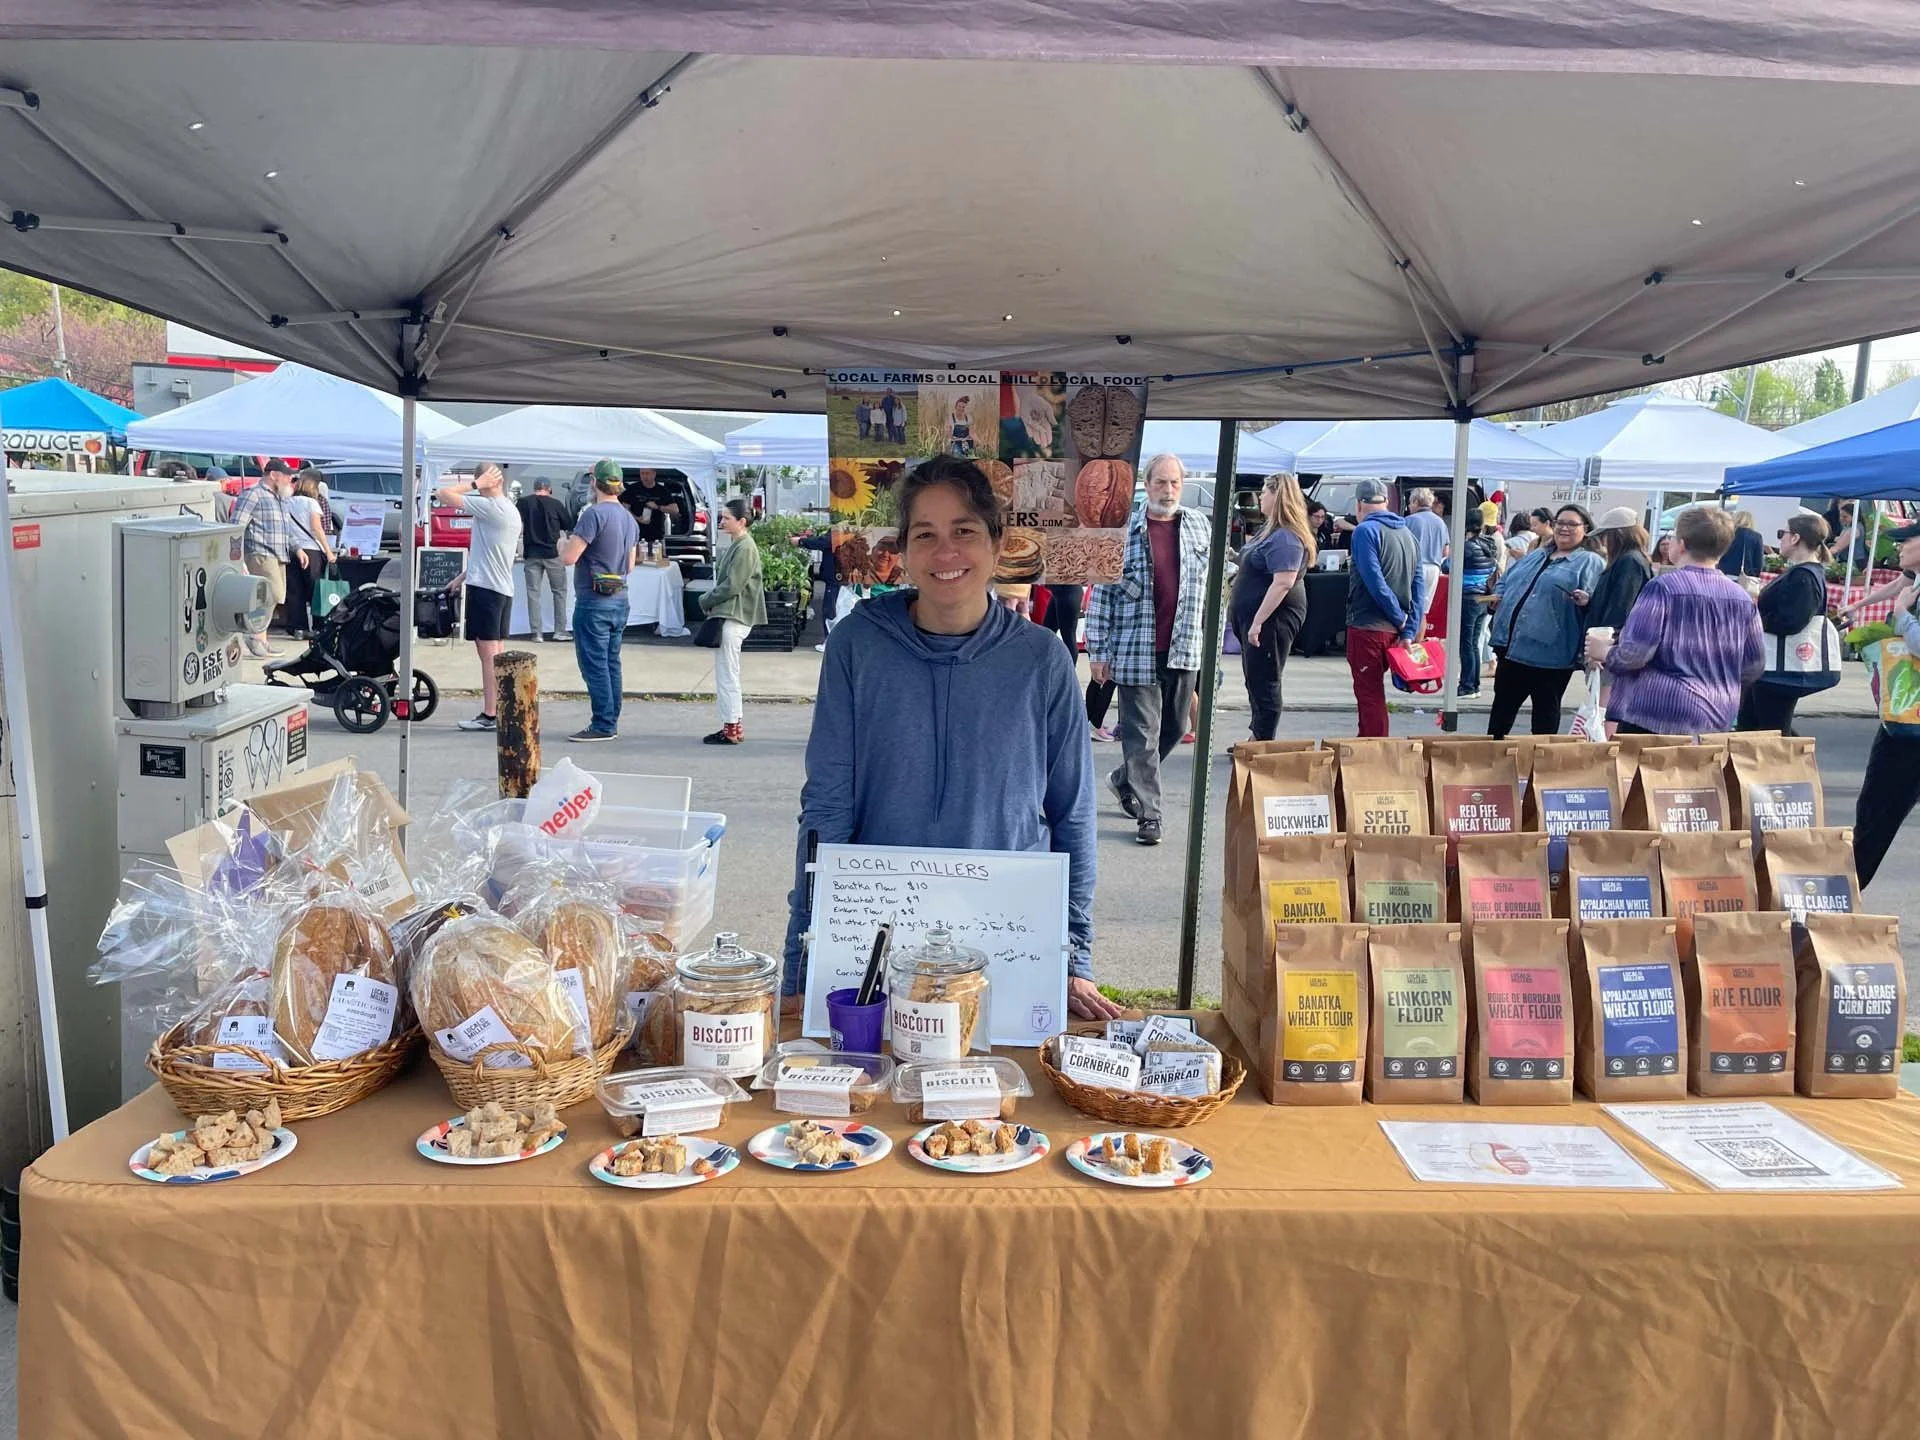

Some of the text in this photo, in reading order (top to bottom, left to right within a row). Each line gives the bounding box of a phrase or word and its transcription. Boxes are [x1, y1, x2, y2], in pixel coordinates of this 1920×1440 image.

[829, 372, 878, 383] LOCAL
[884, 373, 934, 383] FARMS
[948, 374, 997, 384] LOCAL
[1001, 374, 1036, 384] MILL
[1050, 375, 1098, 385] LOCAL
[2, 433, 83, 451] RODUCE
[202, 648, 222, 670] ESE
[1460, 804, 1498, 818] RED FIFE
[1546, 810, 1609, 821] APPALACHIAN WHITE
[1667, 807, 1708, 821] SOFT RED
[1754, 802, 1813, 816] BLUE CLARAGE
[1268, 814, 1329, 830] BUCKWHEAT
[1364, 810, 1409, 825] SPELT
[1449, 817, 1511, 832] WHEAT FLOUR
[1760, 816, 1810, 830] CORN GRITS
[1546, 821, 1578, 836] WHEAT
[1661, 821, 1719, 833] WHEAT FLOUR
[838, 857, 989, 878] LOCAL MILLERS
[833, 880, 928, 892] Banatka Flour $10
[1580, 899, 1649, 910] APPALACHIAN WHITE
[1679, 898, 1744, 919] RYE FLOUR
[1784, 894, 1849, 909] BLUE CLARAGE
[1283, 902, 1326, 918] BANATKA
[1368, 902, 1432, 918] EINKORN
[935, 920, 953, 930] $6
[979, 922, 988, 931] 2
[1007, 921, 1027, 933] $10
[1387, 990, 1453, 1007] EINKORN
[1512, 992, 1520, 1003] DE
[1522, 993, 1561, 1003] BORDEAUX
[1602, 987, 1673, 1002] APPALACHIAN WHITE
[1712, 987, 1782, 1007] RYE FLOUR
[1833, 985, 1896, 999] BLUE CLARAGE
[1298, 995, 1341, 1010] BANATKA
[1603, 1000, 1675, 1019] WHEAT FLOUR
[1838, 1000, 1892, 1015] CORN GRITS
[1288, 1011, 1353, 1026] WHEAT FLOUR
[1398, 1007, 1444, 1023] FLOUR
[1489, 1004, 1563, 1020] WHEAT FLOUR
[894, 1009, 944, 1034] BISCOTTI
[693, 1025, 753, 1043] BISCOTTI
[1069, 1053, 1130, 1078] CORNBREAD
[788, 1074, 852, 1082] BISCOTTI
[926, 1077, 991, 1087] BISCOTTI
[1141, 1068, 1200, 1087] CORNBREAD
[640, 1087, 707, 1100] BISCOTTI
